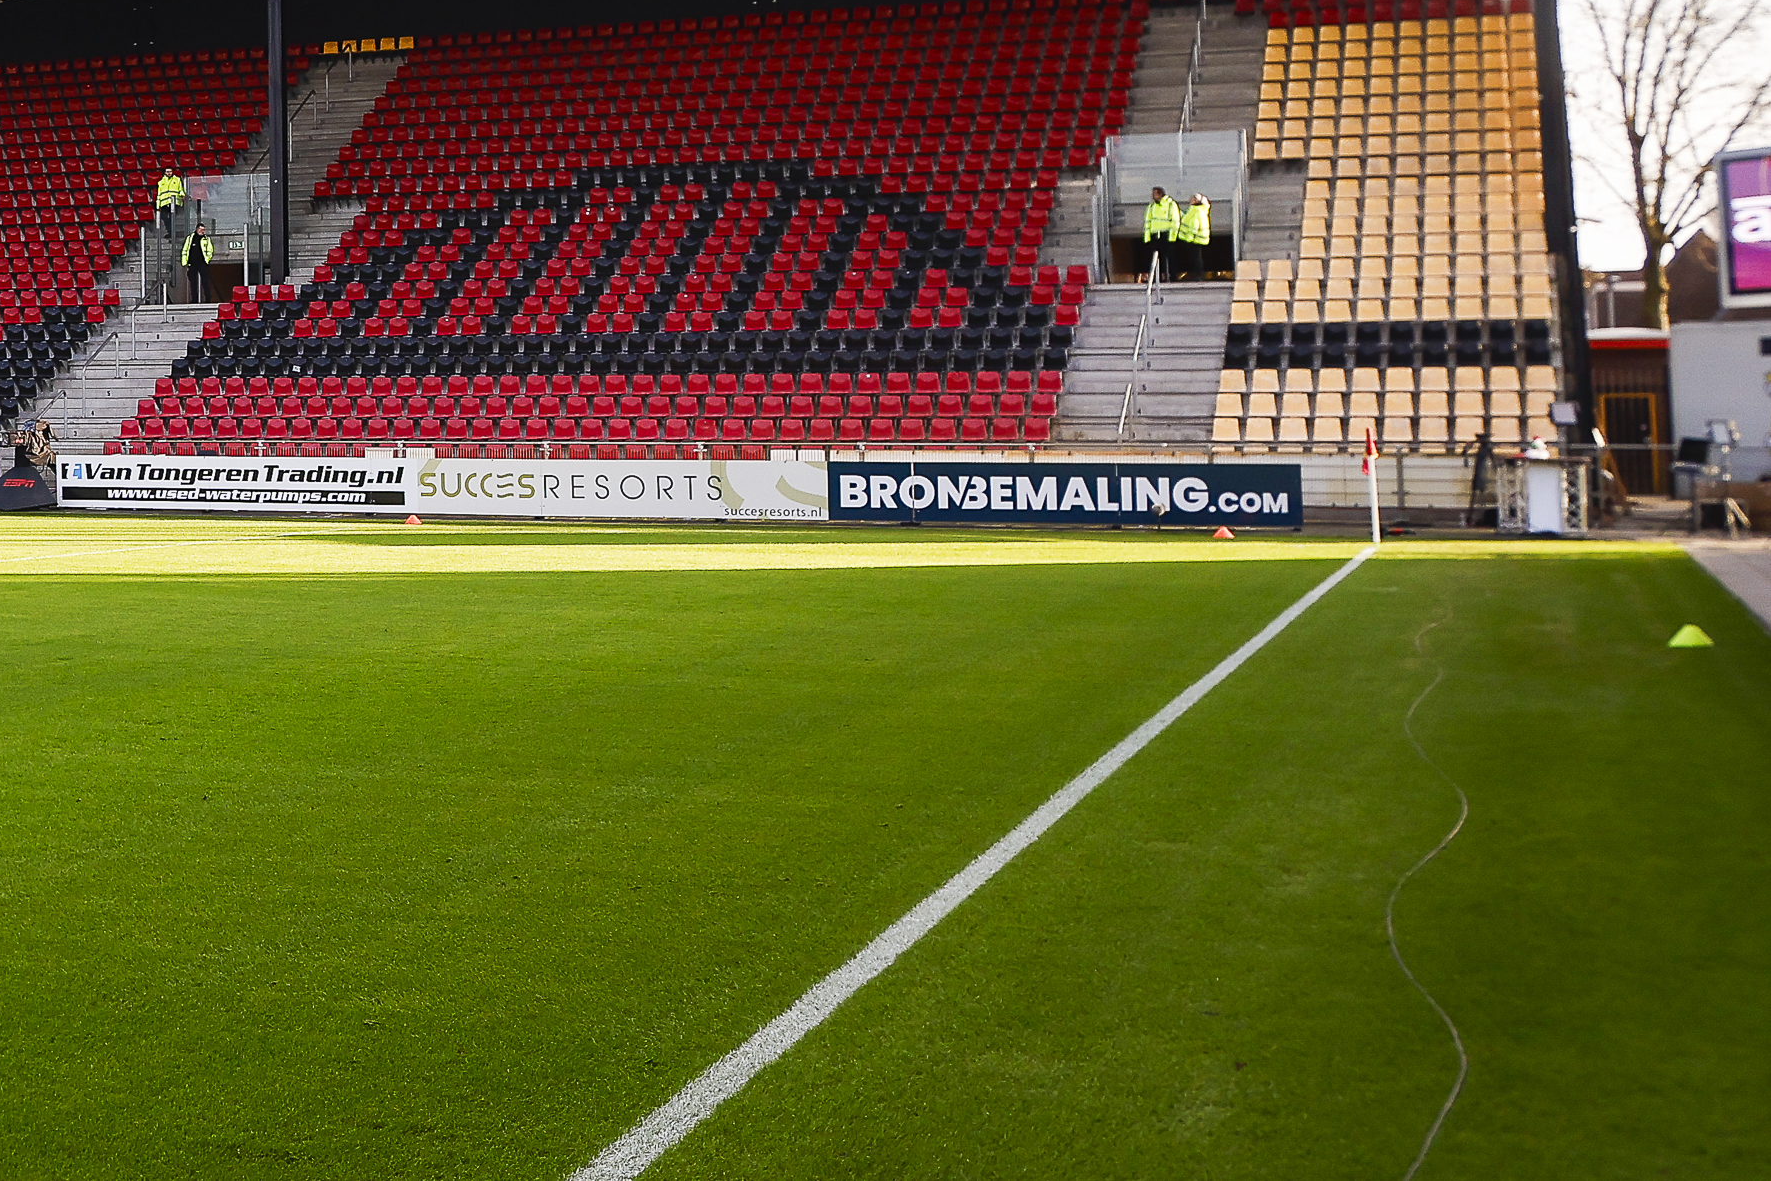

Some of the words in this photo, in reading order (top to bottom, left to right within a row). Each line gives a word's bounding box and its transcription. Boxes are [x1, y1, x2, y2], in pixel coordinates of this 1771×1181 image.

[3, 479, 35, 488] ESPN
[107, 487, 367, 504] www.used-waterpumps.com
[724, 506, 823, 518] succesresorts.nl
